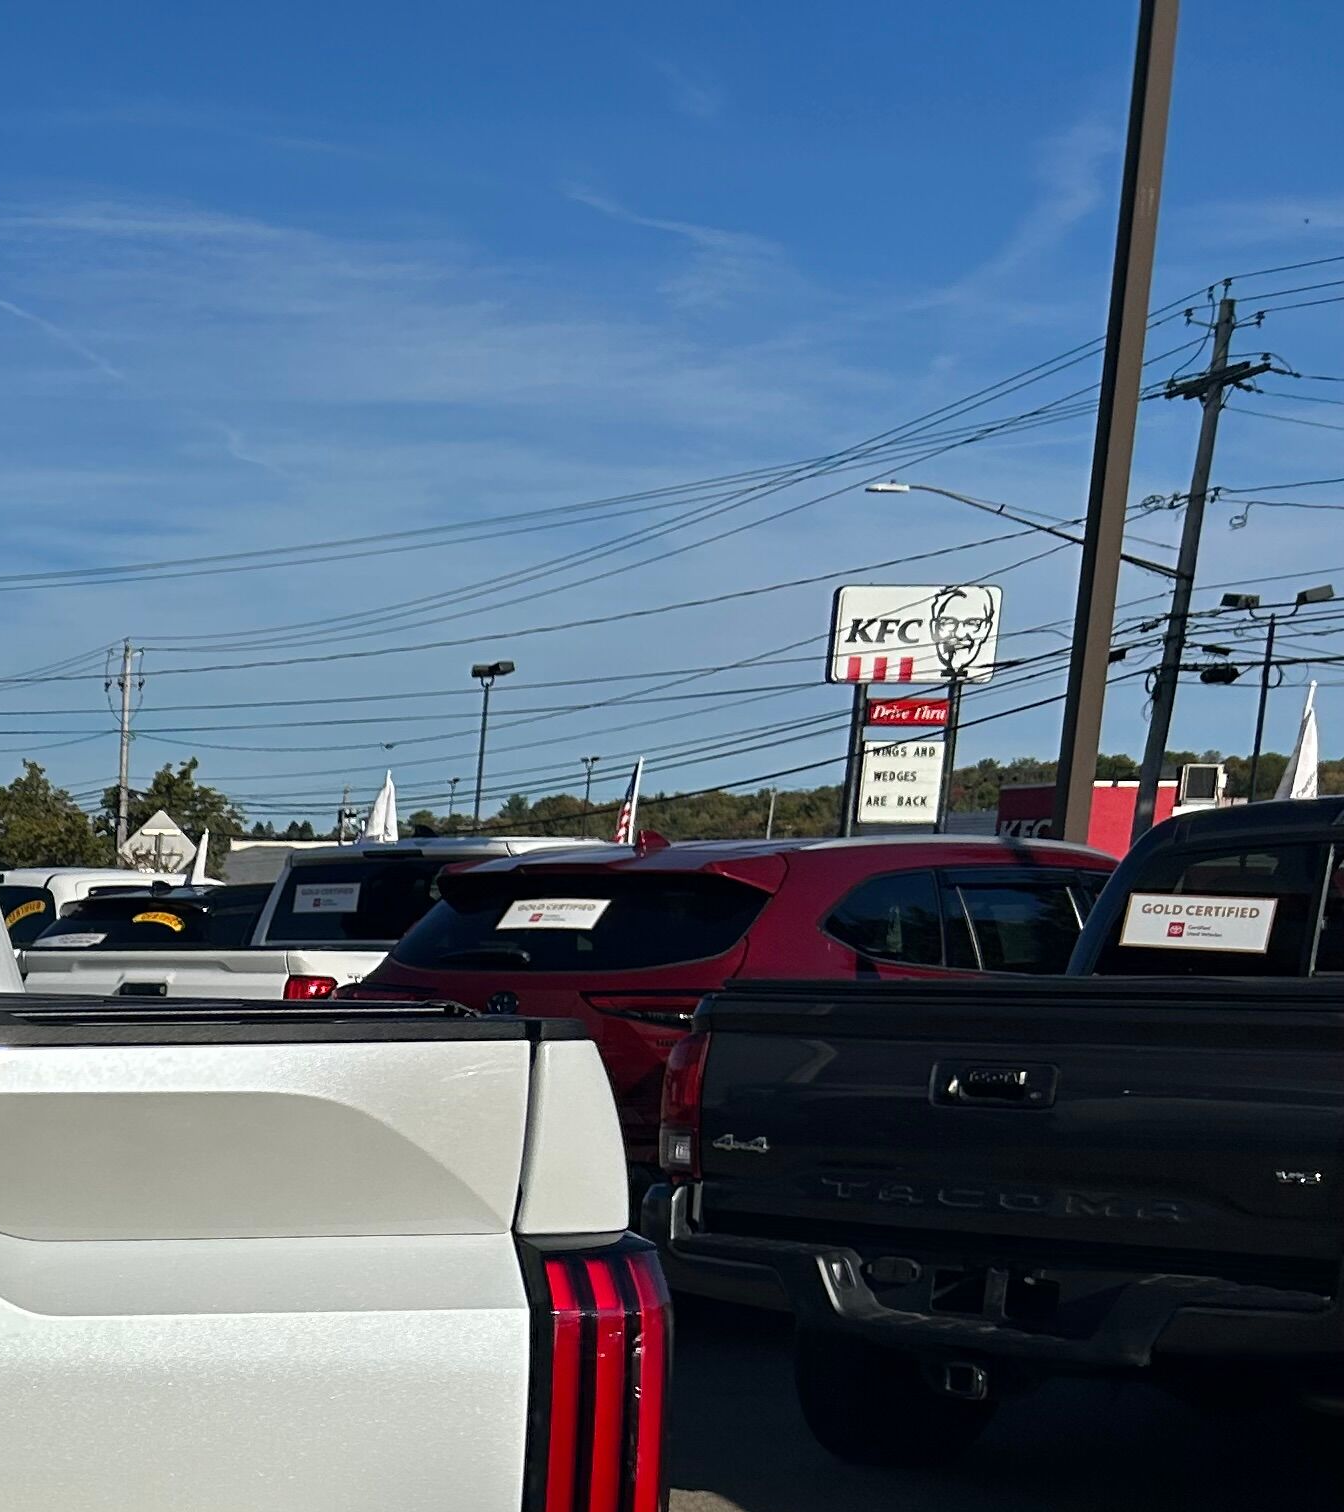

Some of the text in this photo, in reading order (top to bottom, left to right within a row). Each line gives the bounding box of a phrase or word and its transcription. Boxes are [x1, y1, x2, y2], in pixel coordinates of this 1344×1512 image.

[845, 618, 924, 644] KFC
[872, 704, 948, 721] Drive Thru
[872, 745, 937, 758] WINGS AND
[873, 770, 918, 782] WEDGES
[865, 795, 929, 808] ARE BACK
[1141, 902, 1261, 919] GOLD CERTIFIED
[820, 1175, 1194, 1223] TACOMA
